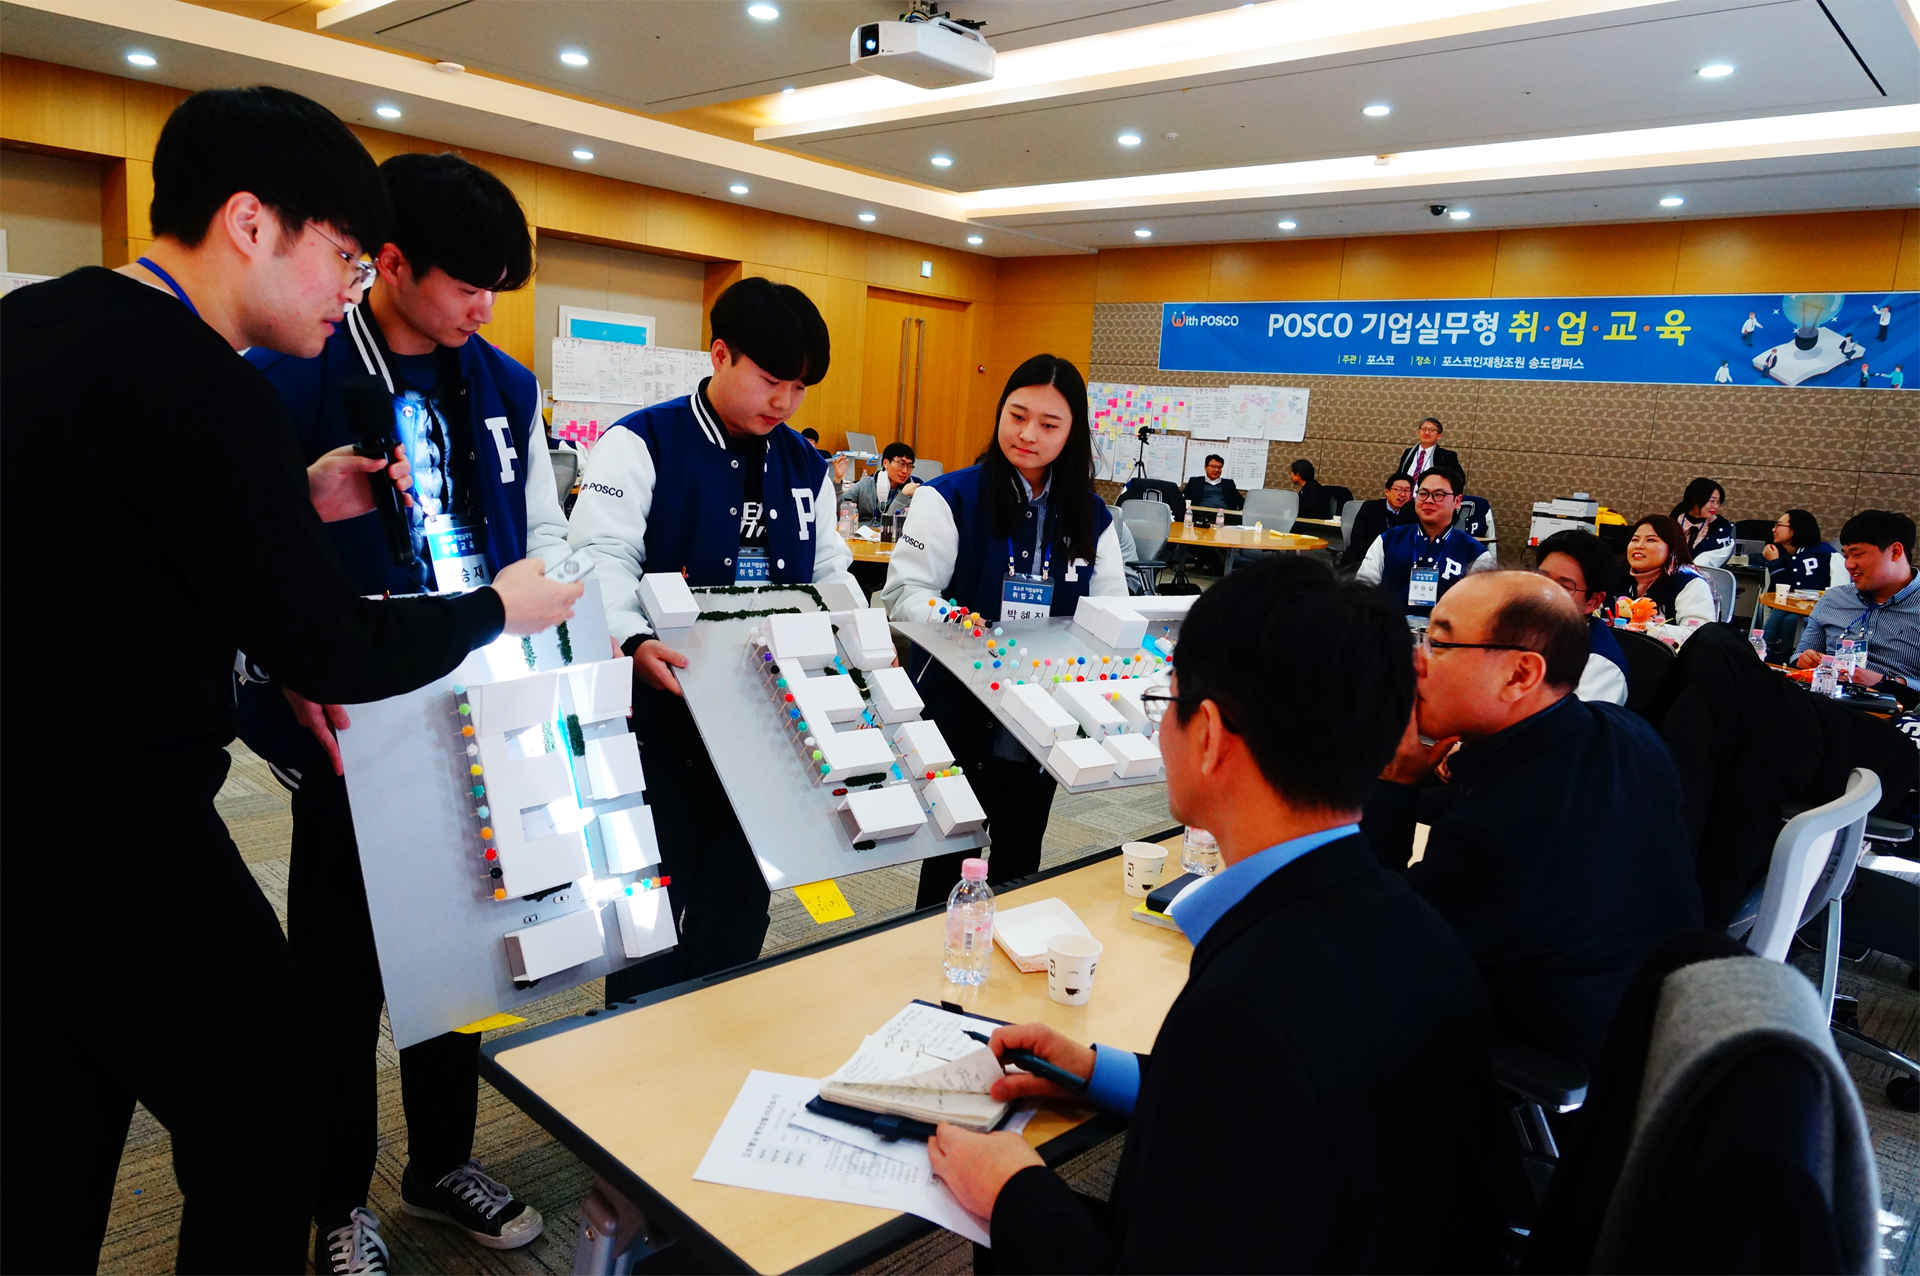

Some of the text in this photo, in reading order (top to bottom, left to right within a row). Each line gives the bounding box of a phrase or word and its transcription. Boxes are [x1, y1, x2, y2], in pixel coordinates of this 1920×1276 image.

[1200, 315, 1239, 326] POSCO
[1268, 313, 1353, 338] POSCO
[1361, 310, 1499, 345] 기업실무형
[1366, 355, 1395, 365] 포스코
[1442, 355, 1525, 369] 포스코인재창조원
[1528, 355, 1584, 370] 송도캠퍼스
[589, 482, 624, 498] POSCO
[791, 488, 816, 540] P
[1470, 521, 1479, 535] P
[902, 534, 925, 550] POSCO
[1442, 557, 1462, 580] P
[1802, 557, 1819, 575] P
